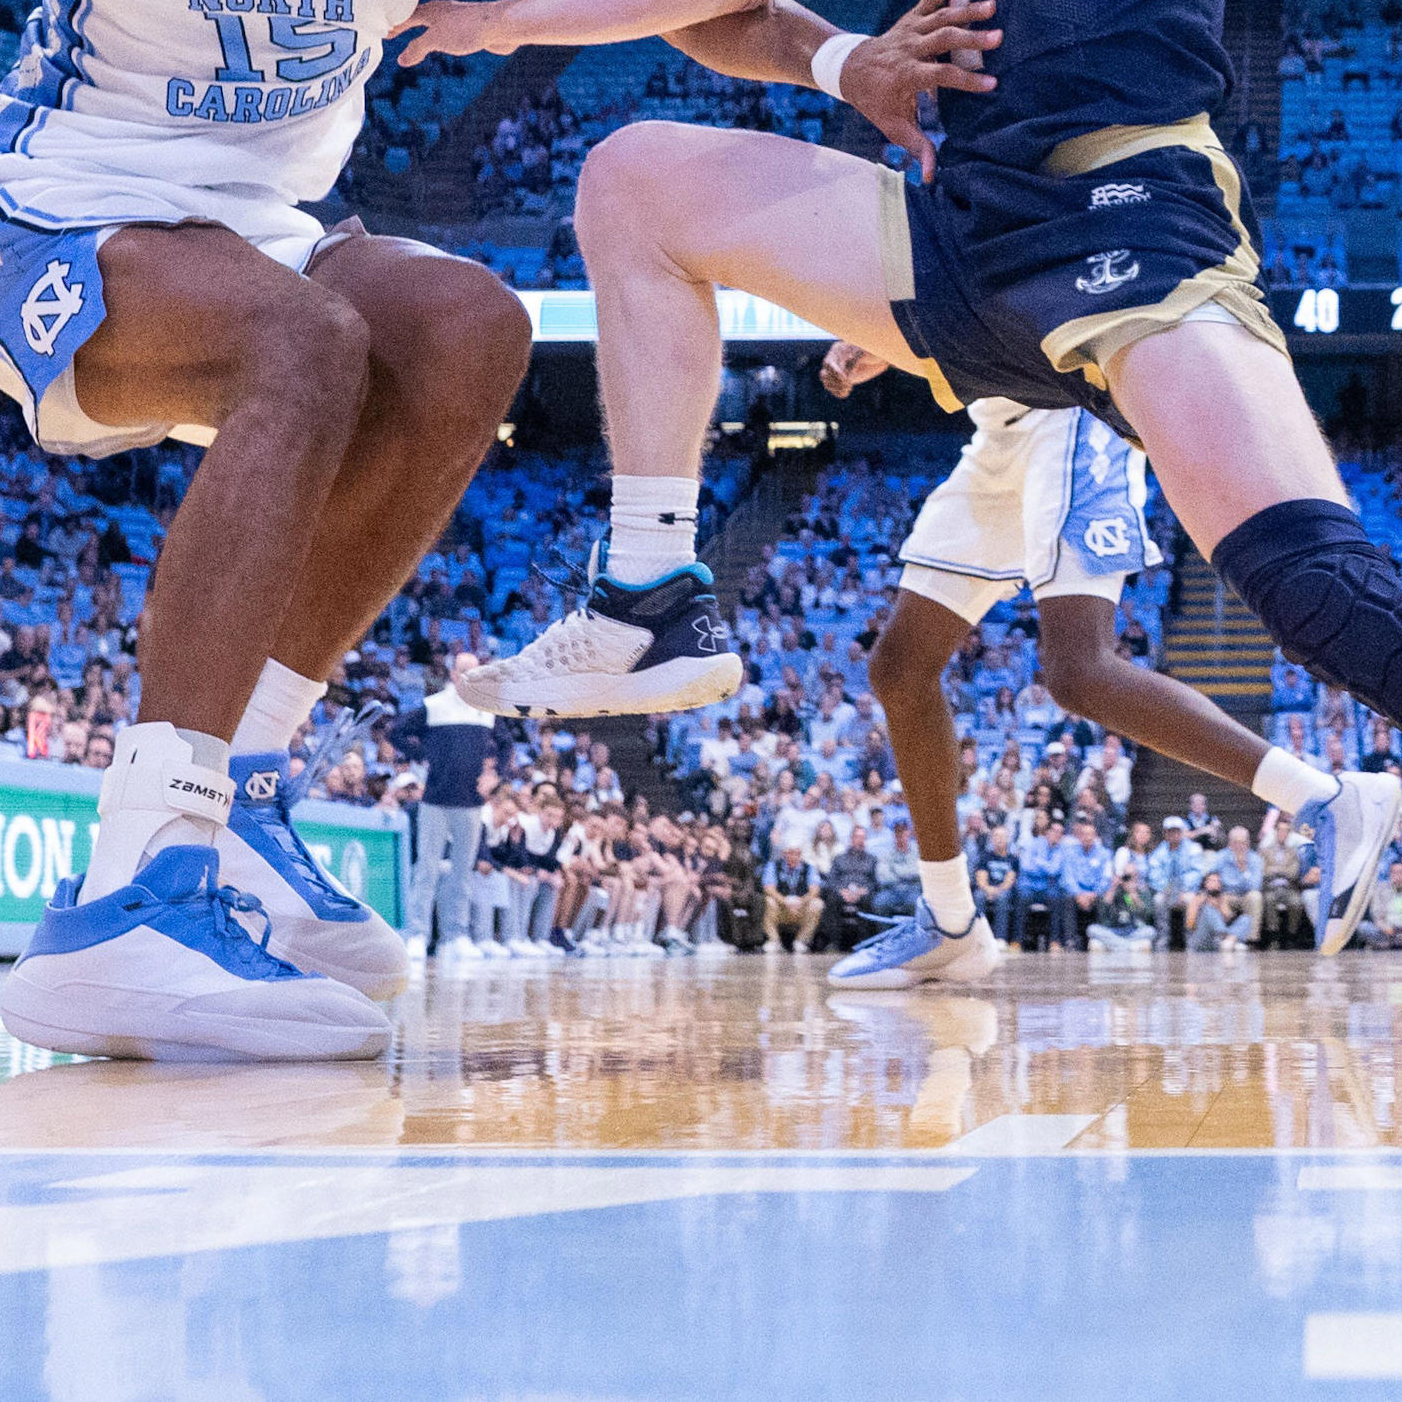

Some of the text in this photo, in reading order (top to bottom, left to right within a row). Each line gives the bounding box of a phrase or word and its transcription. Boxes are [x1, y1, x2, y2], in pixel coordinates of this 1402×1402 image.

[203, 12, 358, 83] 15
[166, 46, 371, 124] CAROLINA
[1293, 287, 1340, 333] 40
